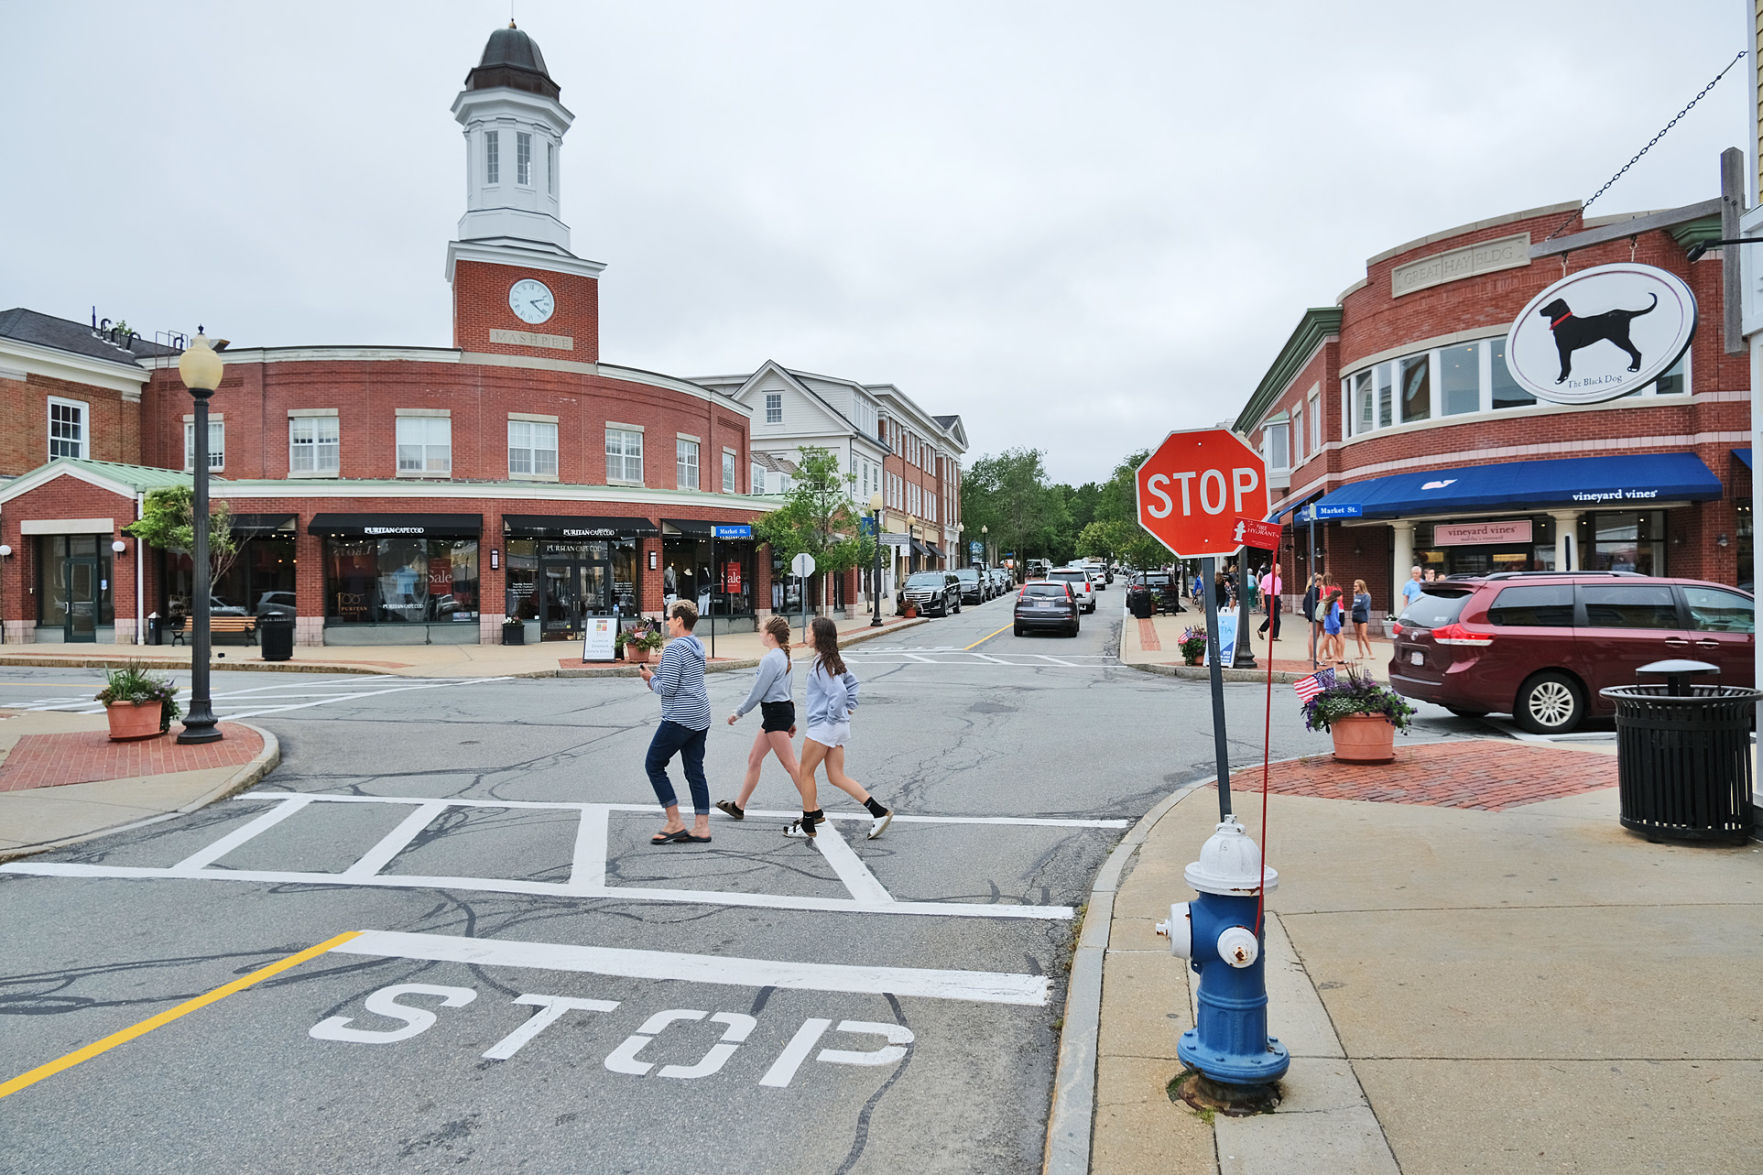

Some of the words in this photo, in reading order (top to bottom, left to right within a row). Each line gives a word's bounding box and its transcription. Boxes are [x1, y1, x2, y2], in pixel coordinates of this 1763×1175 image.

[1404, 263, 1440, 285] GREAT
[1444, 255, 1471, 274] HAY
[1475, 246, 1513, 266] BLDG
[495, 331, 569, 349] MASHPEE
[1568, 380, 1582, 389] The
[1583, 376, 1603, 386] Black
[1604, 374, 1623, 384] Dog
[1147, 467, 1259, 519] STOP
[1572, 488, 1622, 503] vineyard
[1320, 507, 1345, 515] Market
[1448, 525, 1488, 538] vineyard
[546, 544, 575, 552] PURITAN
[429, 570, 452, 584] Sale
[308, 983, 915, 1089] STOP
